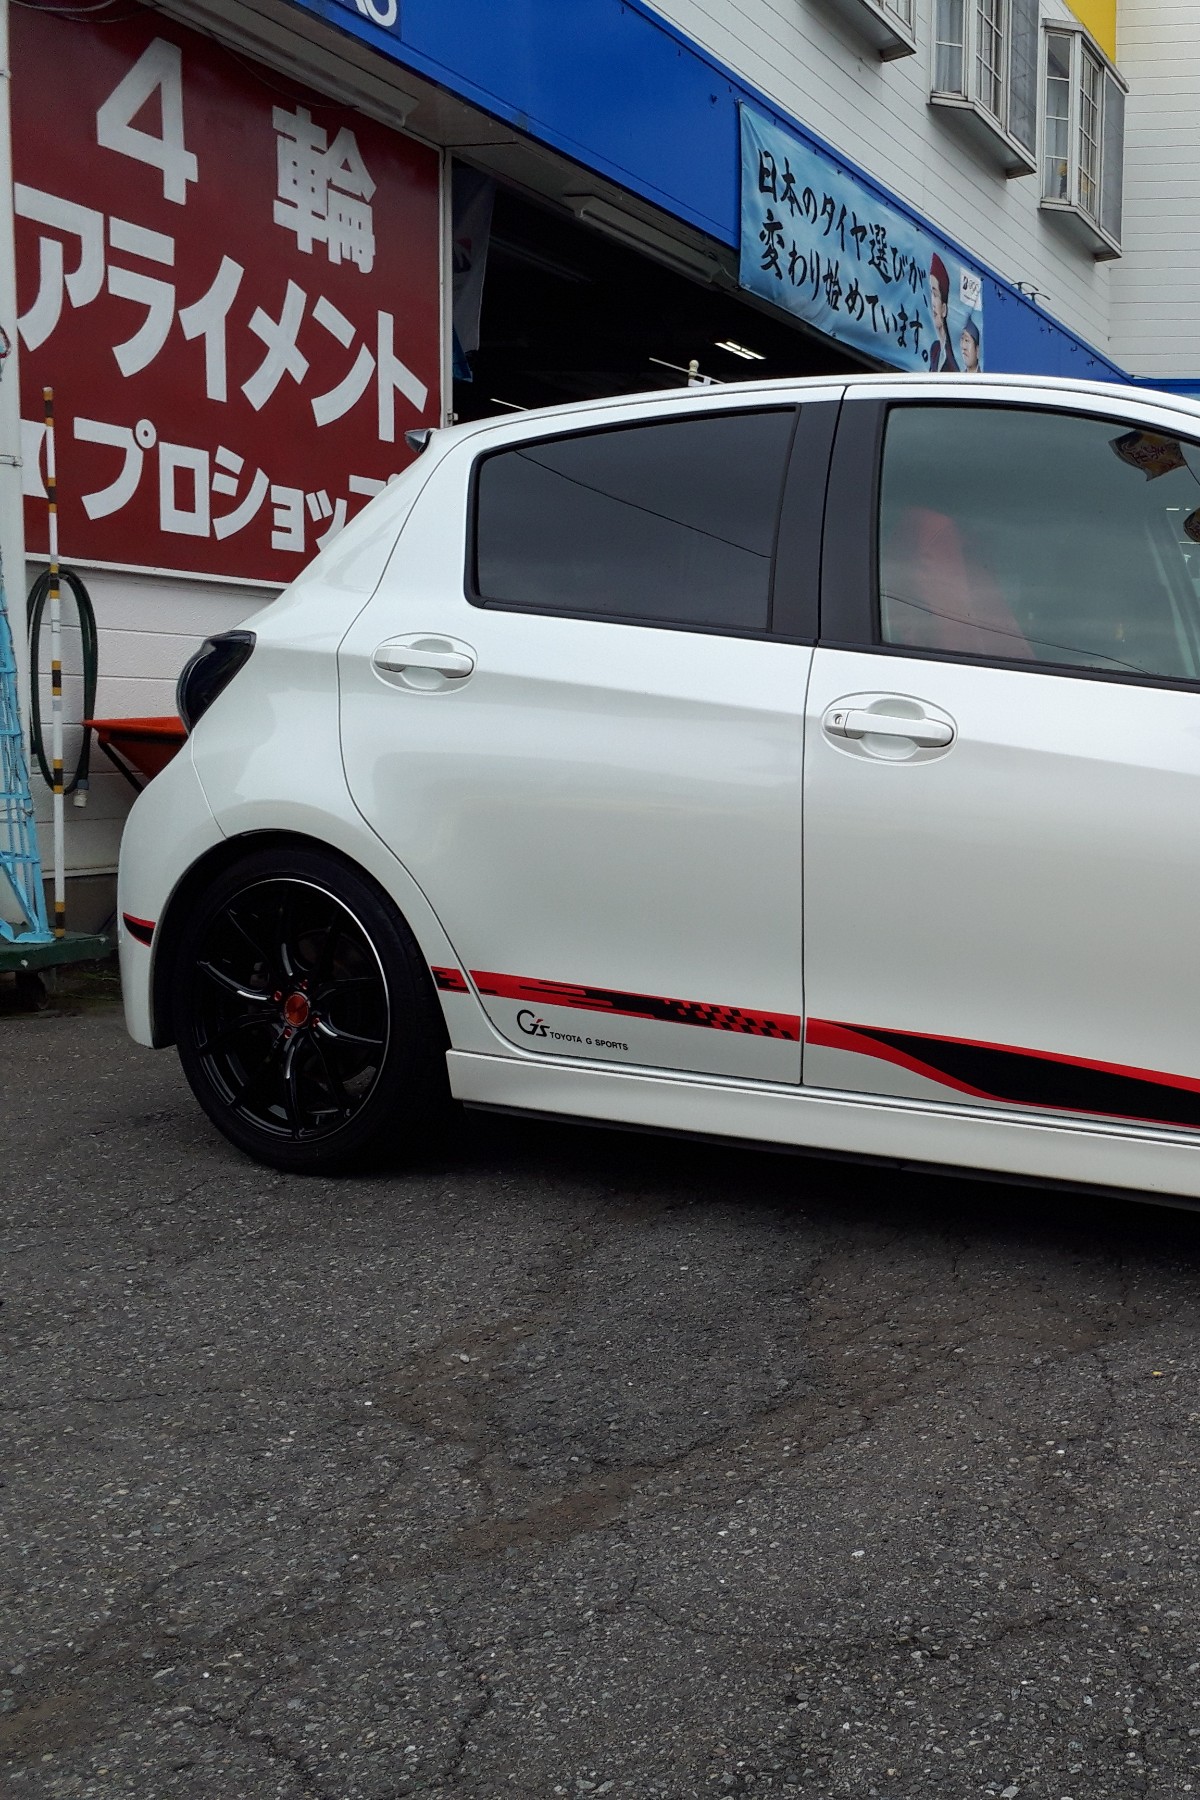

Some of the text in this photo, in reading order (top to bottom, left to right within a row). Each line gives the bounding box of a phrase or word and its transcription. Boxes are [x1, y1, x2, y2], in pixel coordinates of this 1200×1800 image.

[15, 182, 428, 443] アライメント
[759, 209, 929, 362] 変わり始めています。
[550, 1031, 628, 1050] TOYOTA G SPORTS
